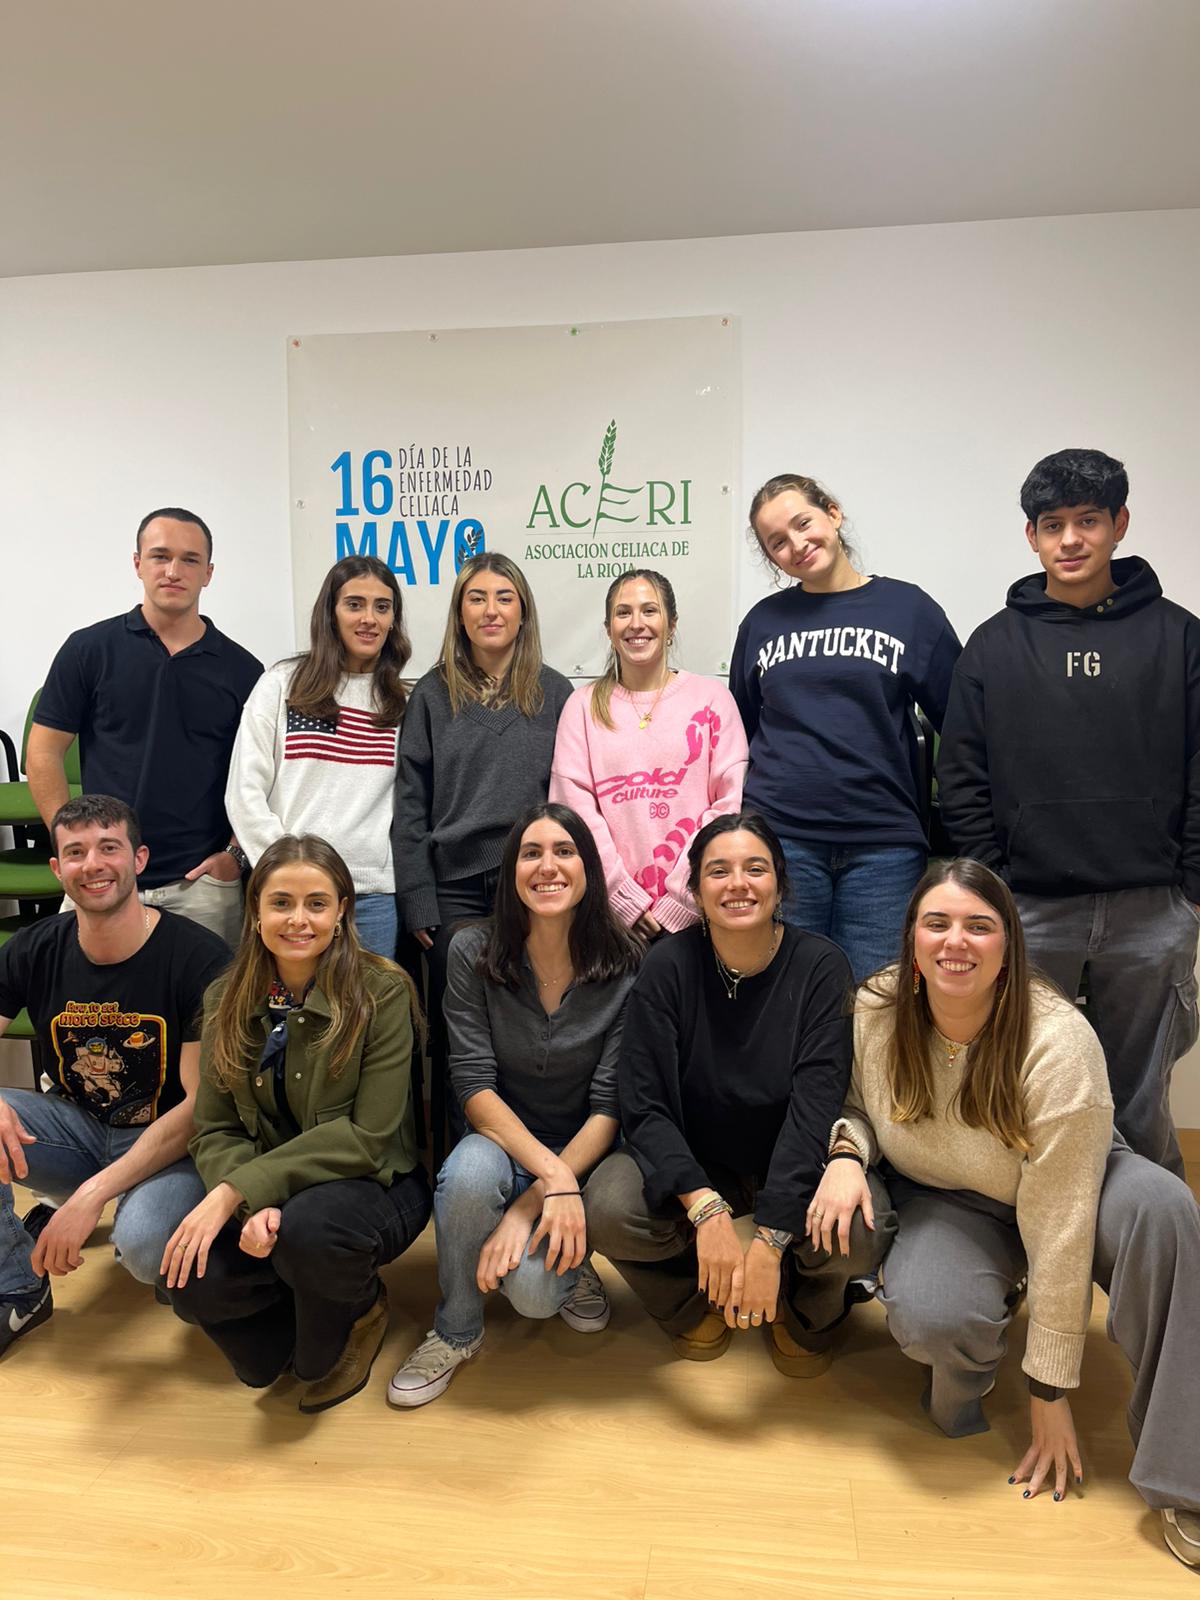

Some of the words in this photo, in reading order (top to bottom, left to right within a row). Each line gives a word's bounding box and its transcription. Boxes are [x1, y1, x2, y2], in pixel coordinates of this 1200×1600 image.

[399, 443, 425, 469] DÍA
[432, 446, 448, 469] DE
[456, 446, 472, 468] LA
[330, 449, 394, 516] 16
[399, 469, 493, 493] ENFERMEDAD
[399, 494, 459, 517] CELIACA
[525, 472, 692, 539] ACERI
[525, 543, 609, 560] ASOCIACION
[611, 541, 669, 558] CELIACA
[671, 540, 690, 557] DE
[577, 563, 594, 578] LA
[756, 626, 905, 678] NANTUCKET
[1066, 651, 1101, 677] FG
[612, 786, 679, 804] culture
